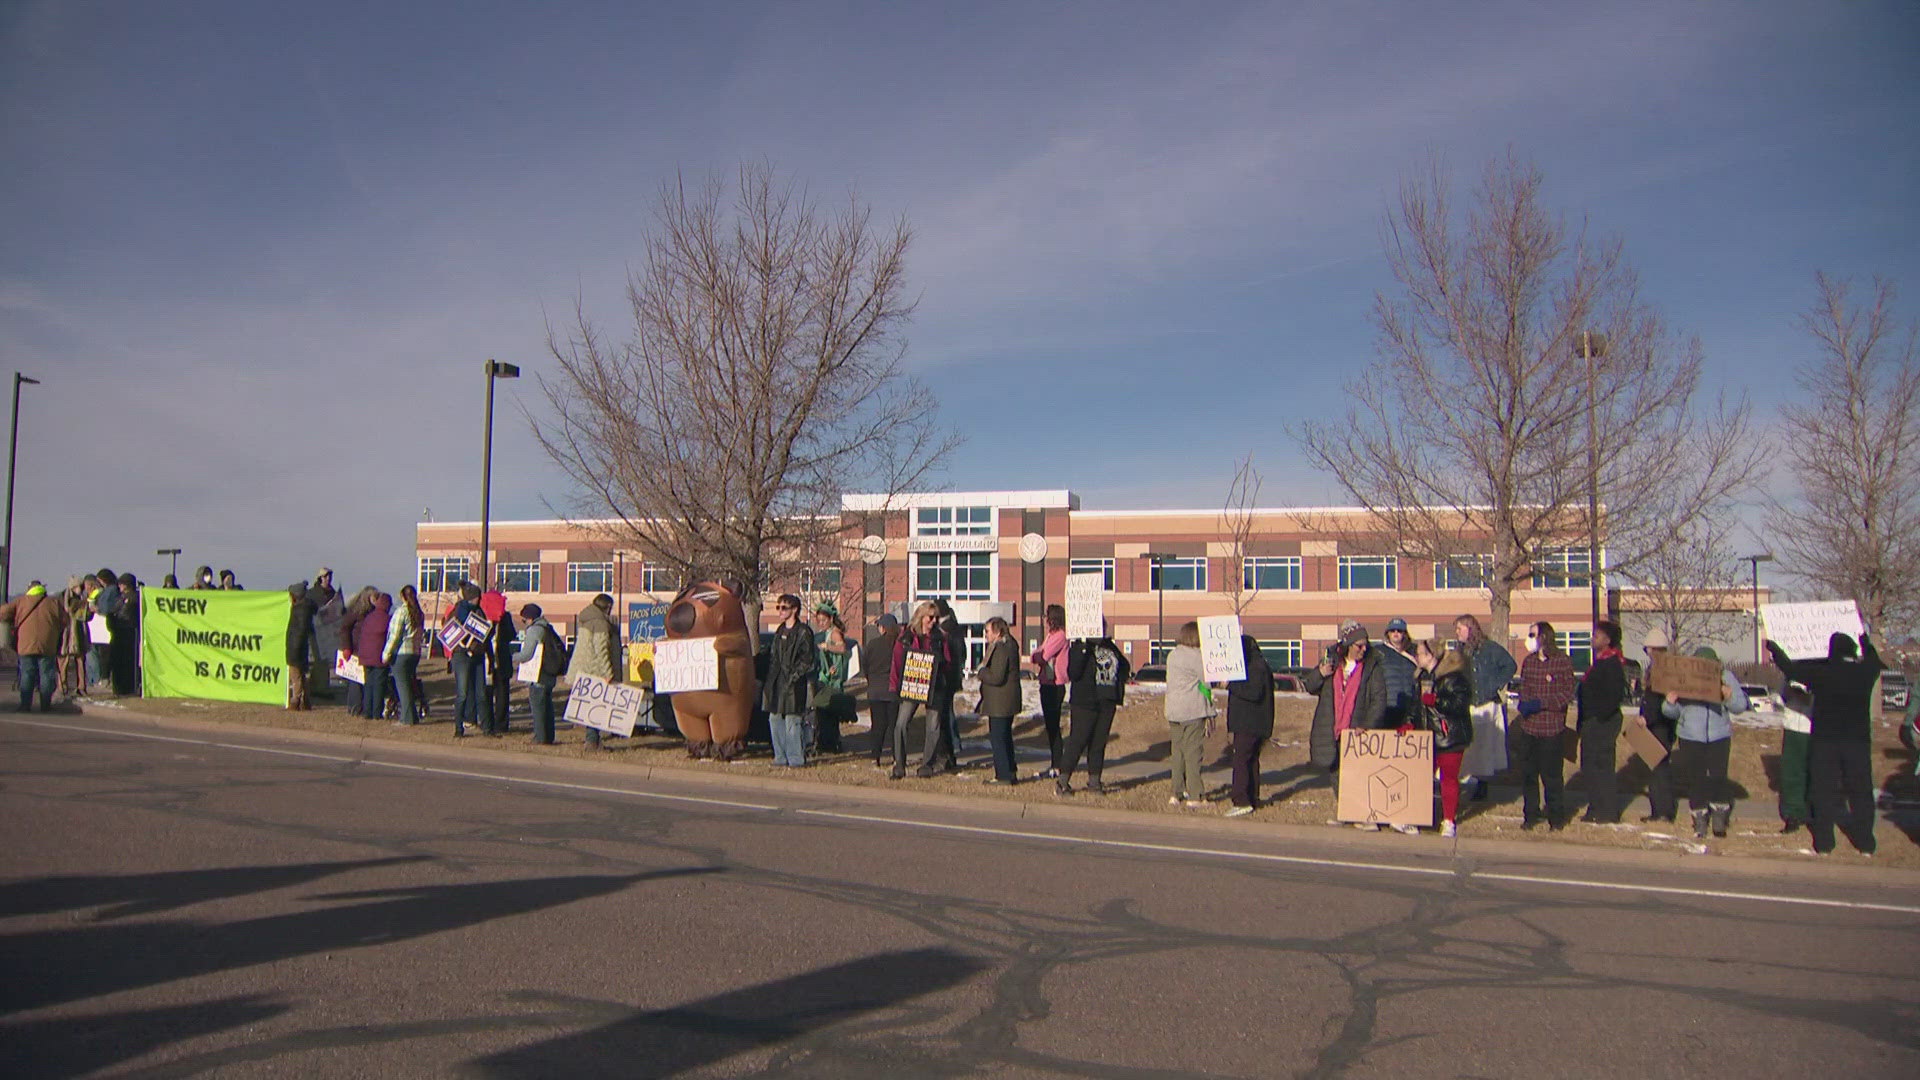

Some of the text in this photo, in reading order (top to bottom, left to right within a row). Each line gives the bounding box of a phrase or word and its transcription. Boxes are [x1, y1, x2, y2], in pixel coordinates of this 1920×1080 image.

[954, 540, 996, 549] BUILDING
[156, 597, 207, 615] EVERY
[630, 608, 650, 620] TACOS
[176, 628, 263, 651] IMMIGRANT
[657, 641, 685, 666] STOP
[686, 640, 715, 663] ICE
[194, 660, 280, 684] IS A STORY
[656, 665, 717, 690] ABDUCTIONS
[572, 677, 641, 713] ABOLISH
[567, 698, 628, 730] ICE
[1343, 731, 1430, 760] ABOLISH
